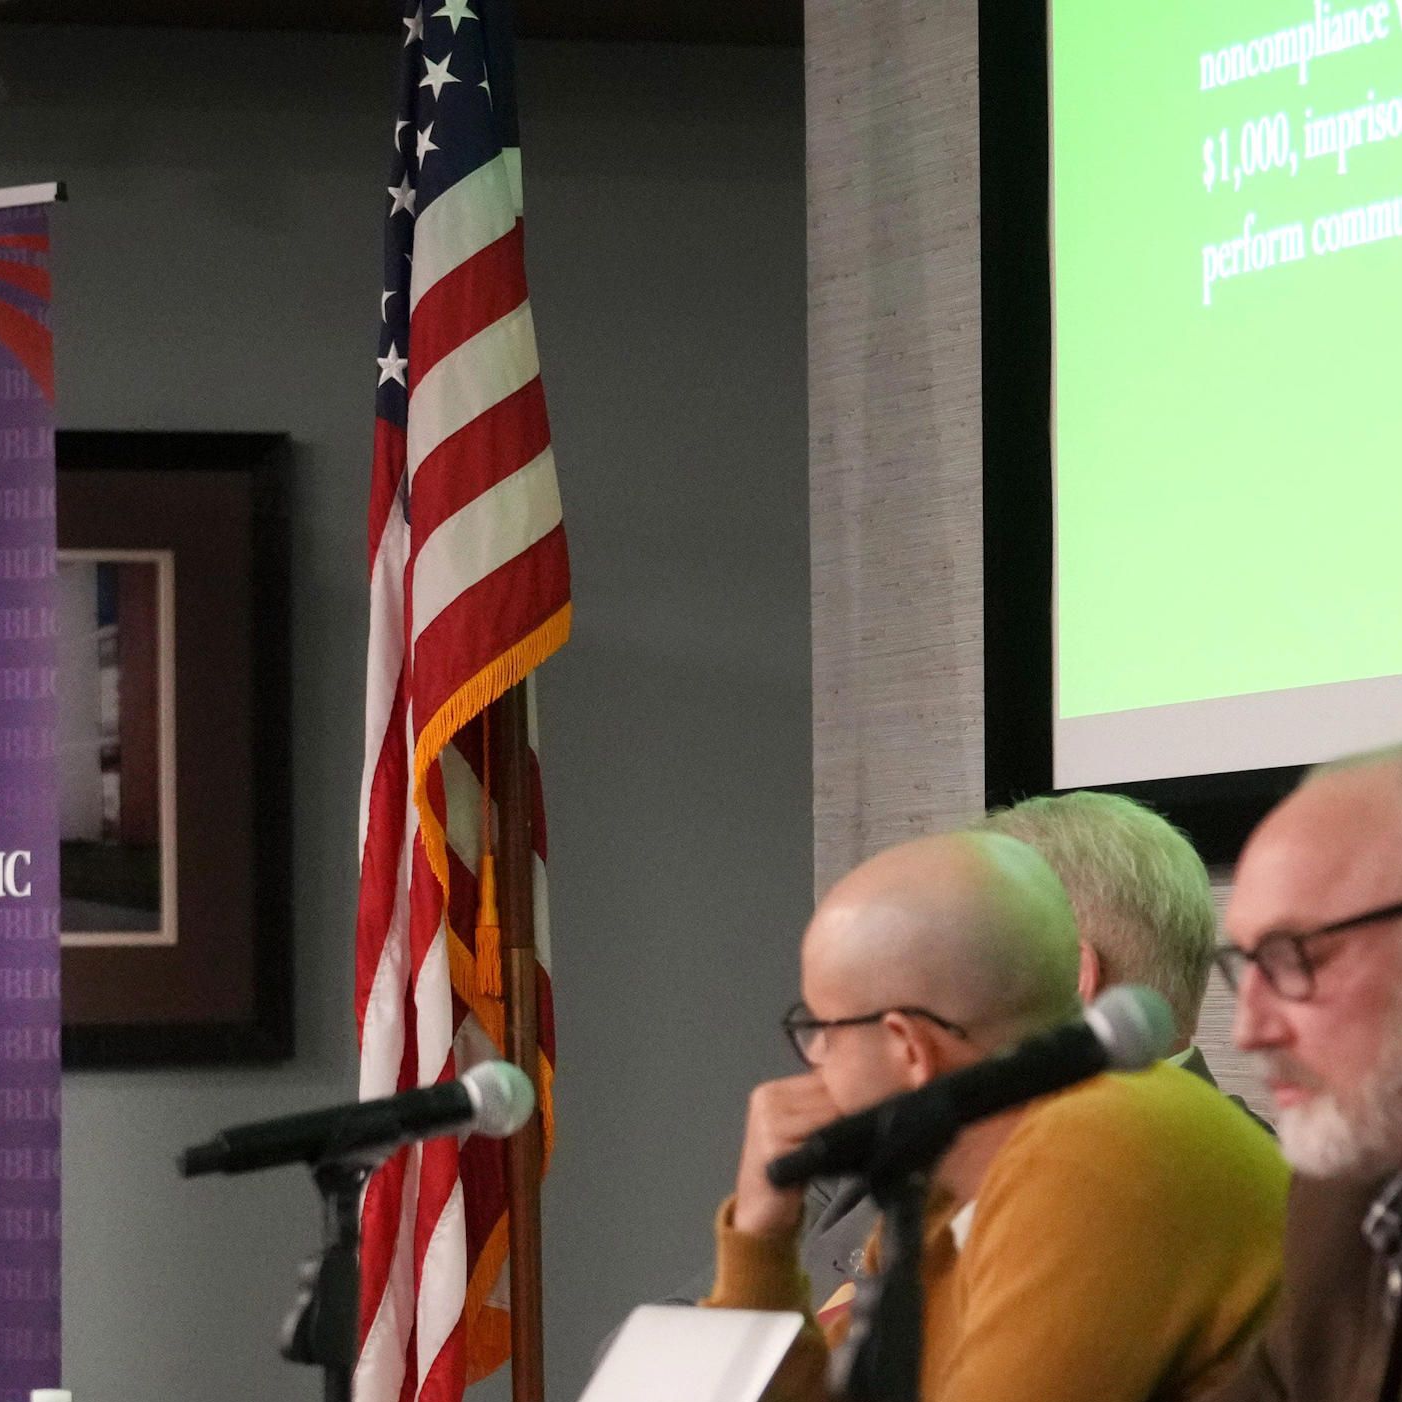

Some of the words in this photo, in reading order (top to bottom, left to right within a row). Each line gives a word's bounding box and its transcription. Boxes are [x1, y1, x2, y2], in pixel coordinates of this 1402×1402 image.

[1200, 0, 1390, 91] noncompliance
[1202, 109, 1300, 194] $1,000,
[1202, 210, 1307, 307] perform
